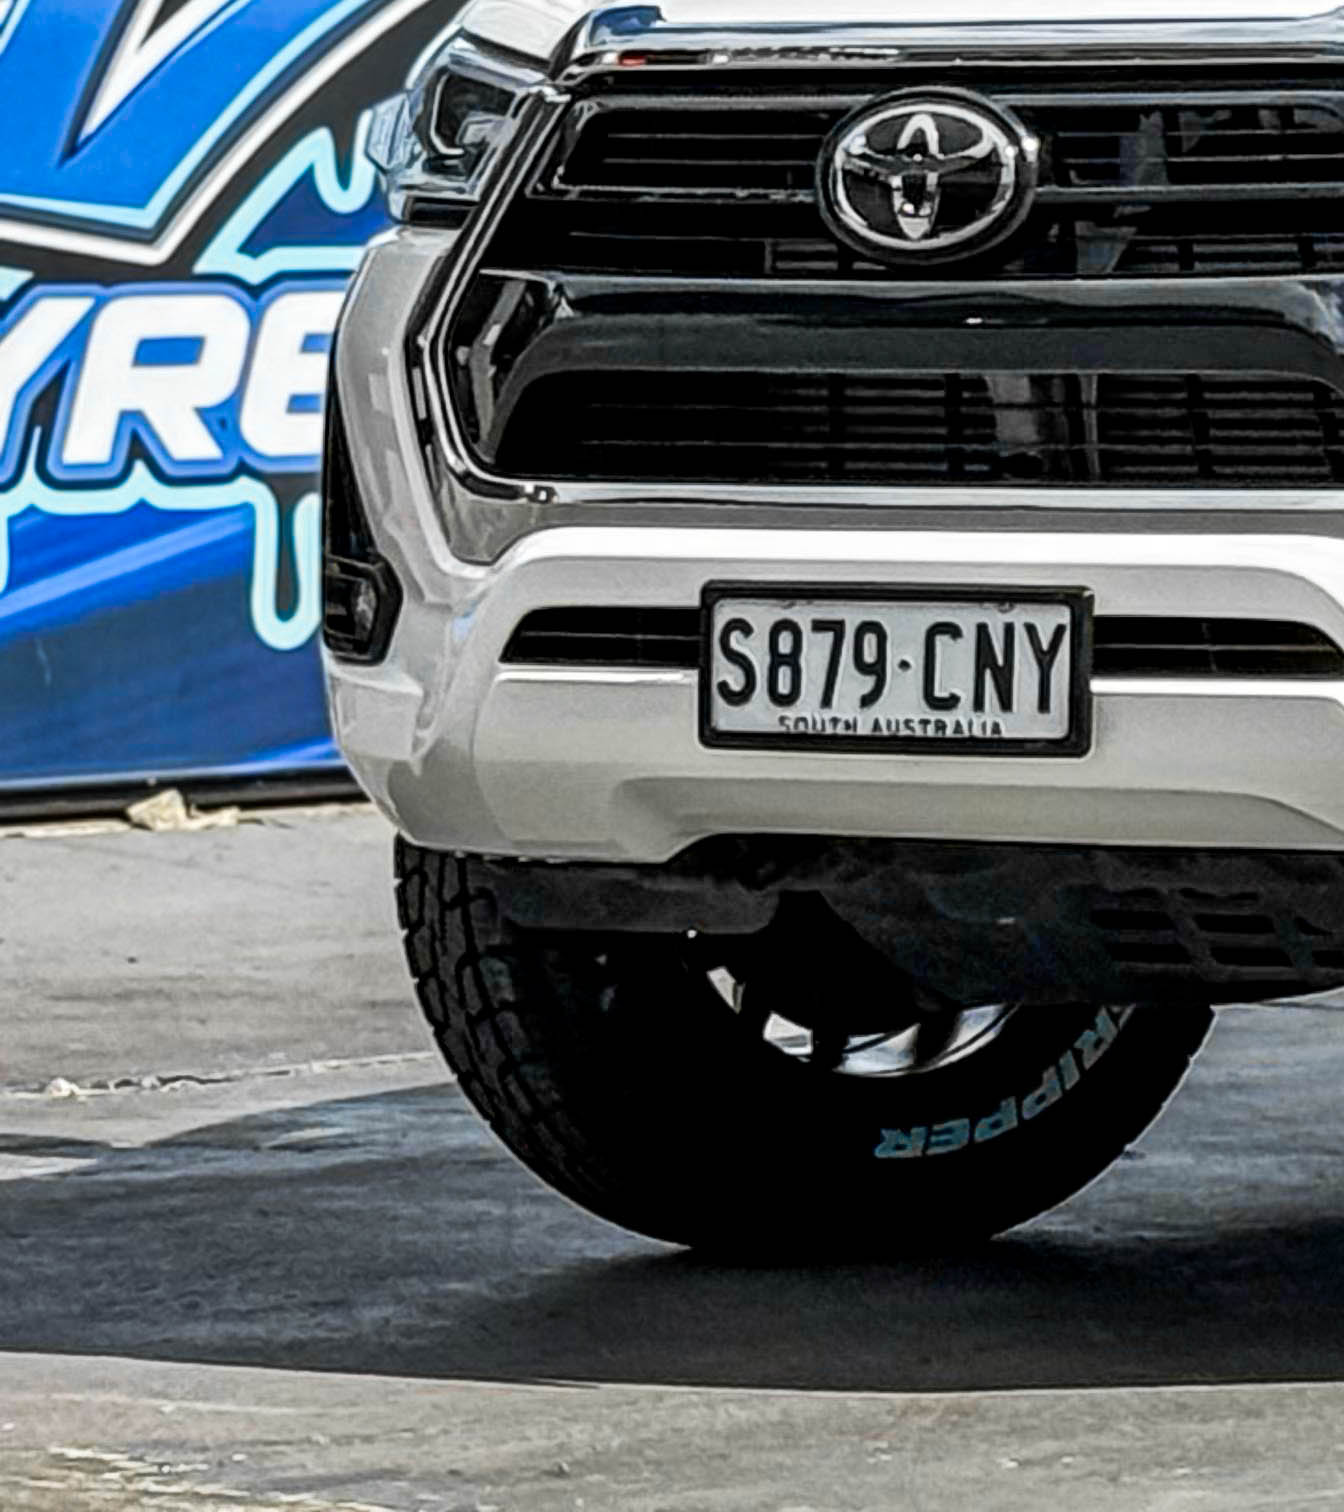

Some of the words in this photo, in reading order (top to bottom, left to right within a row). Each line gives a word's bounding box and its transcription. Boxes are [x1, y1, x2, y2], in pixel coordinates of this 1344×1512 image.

[777, 714, 858, 734] SOUTH
[870, 716, 1004, 738] AUSTRALIA
[873, 1003, 1136, 1159] RIPPER
